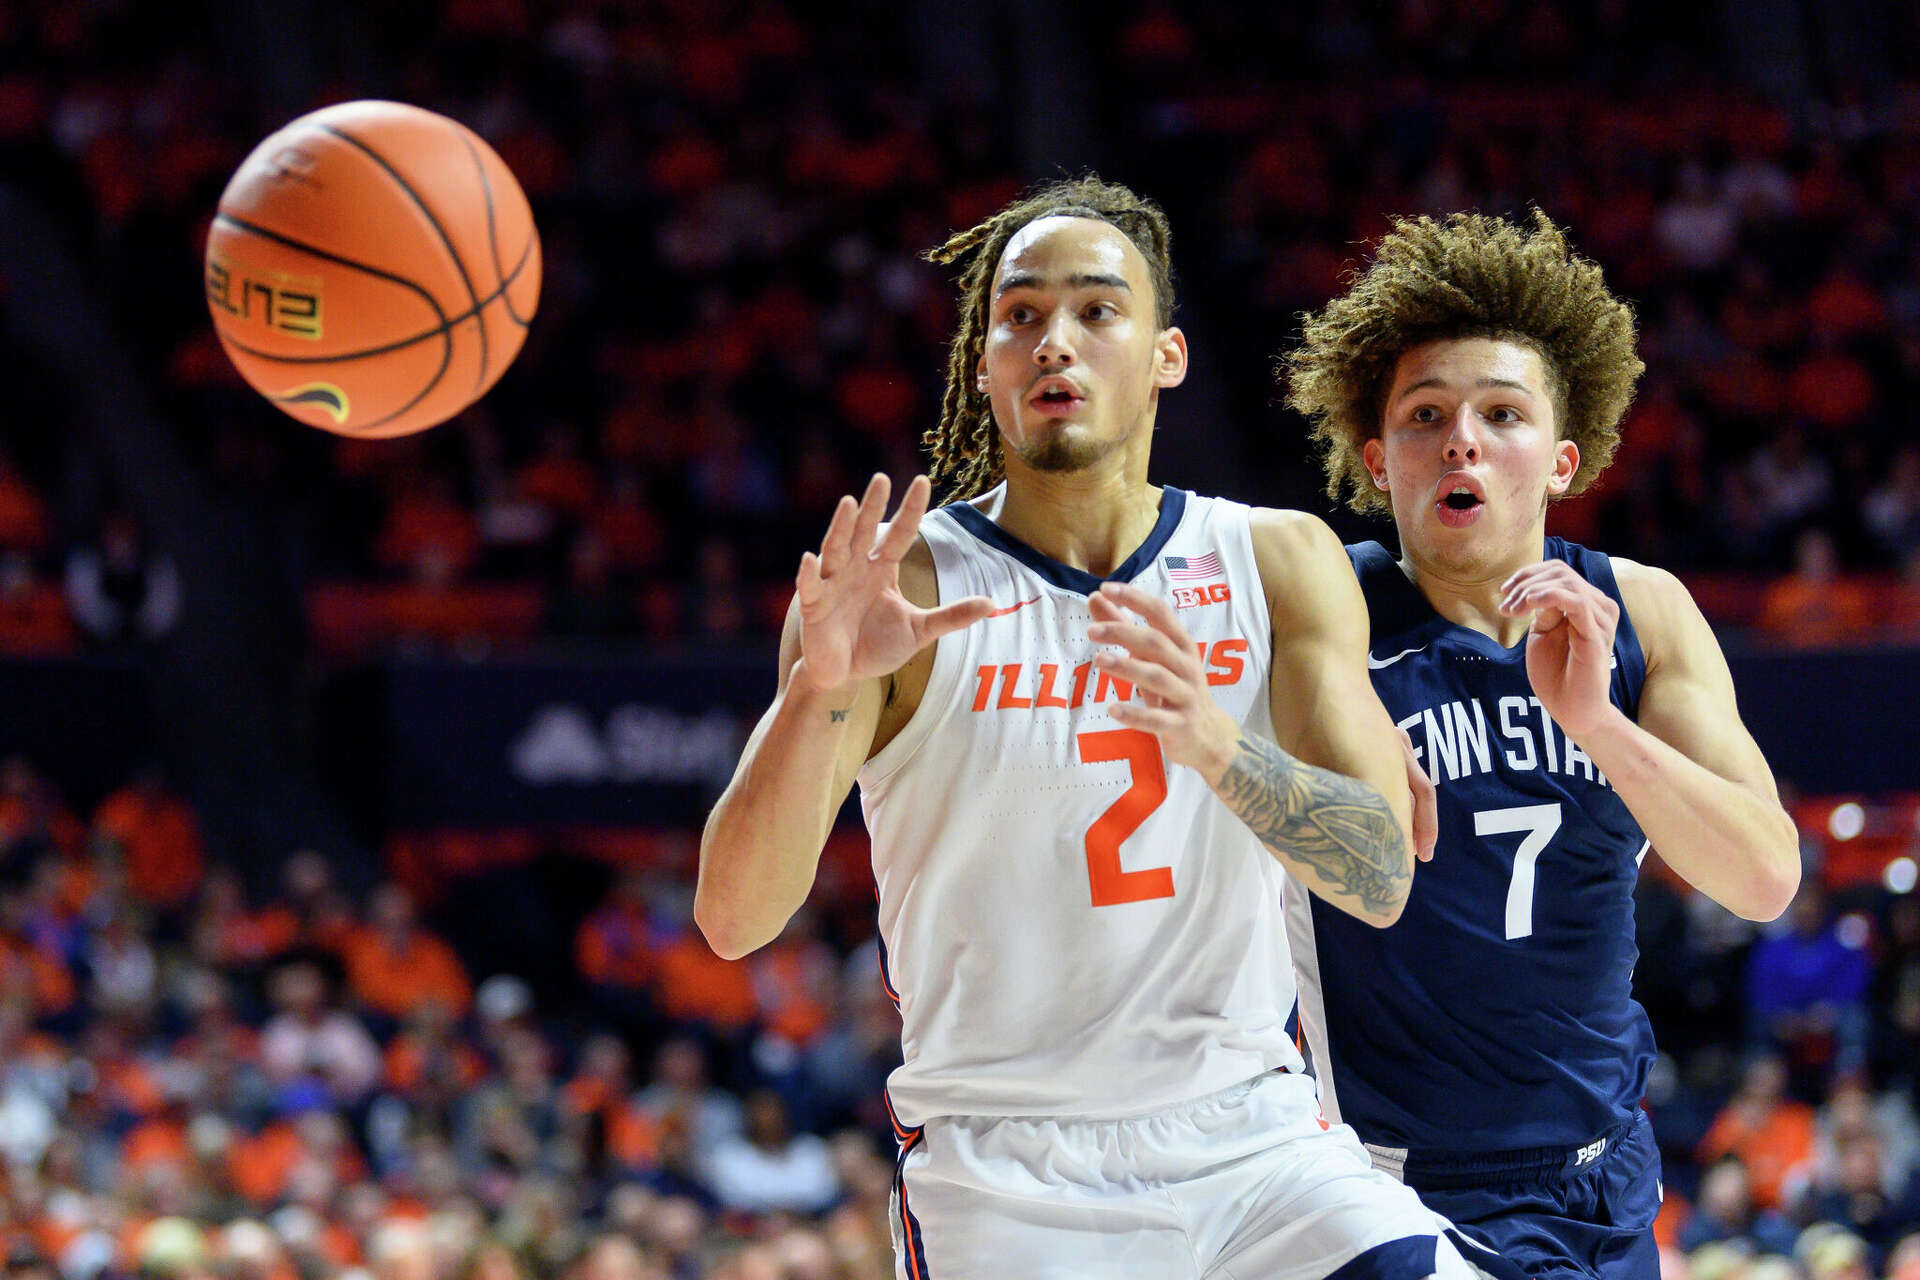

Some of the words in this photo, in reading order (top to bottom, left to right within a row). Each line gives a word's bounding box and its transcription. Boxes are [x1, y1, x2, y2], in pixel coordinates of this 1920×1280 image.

[972, 639, 1248, 712] ILLINS
[1499, 695, 1617, 792] STA
[1077, 728, 1176, 908] 2
[1473, 803, 1562, 940] 7
[1575, 1138, 1606, 1166] PSU
